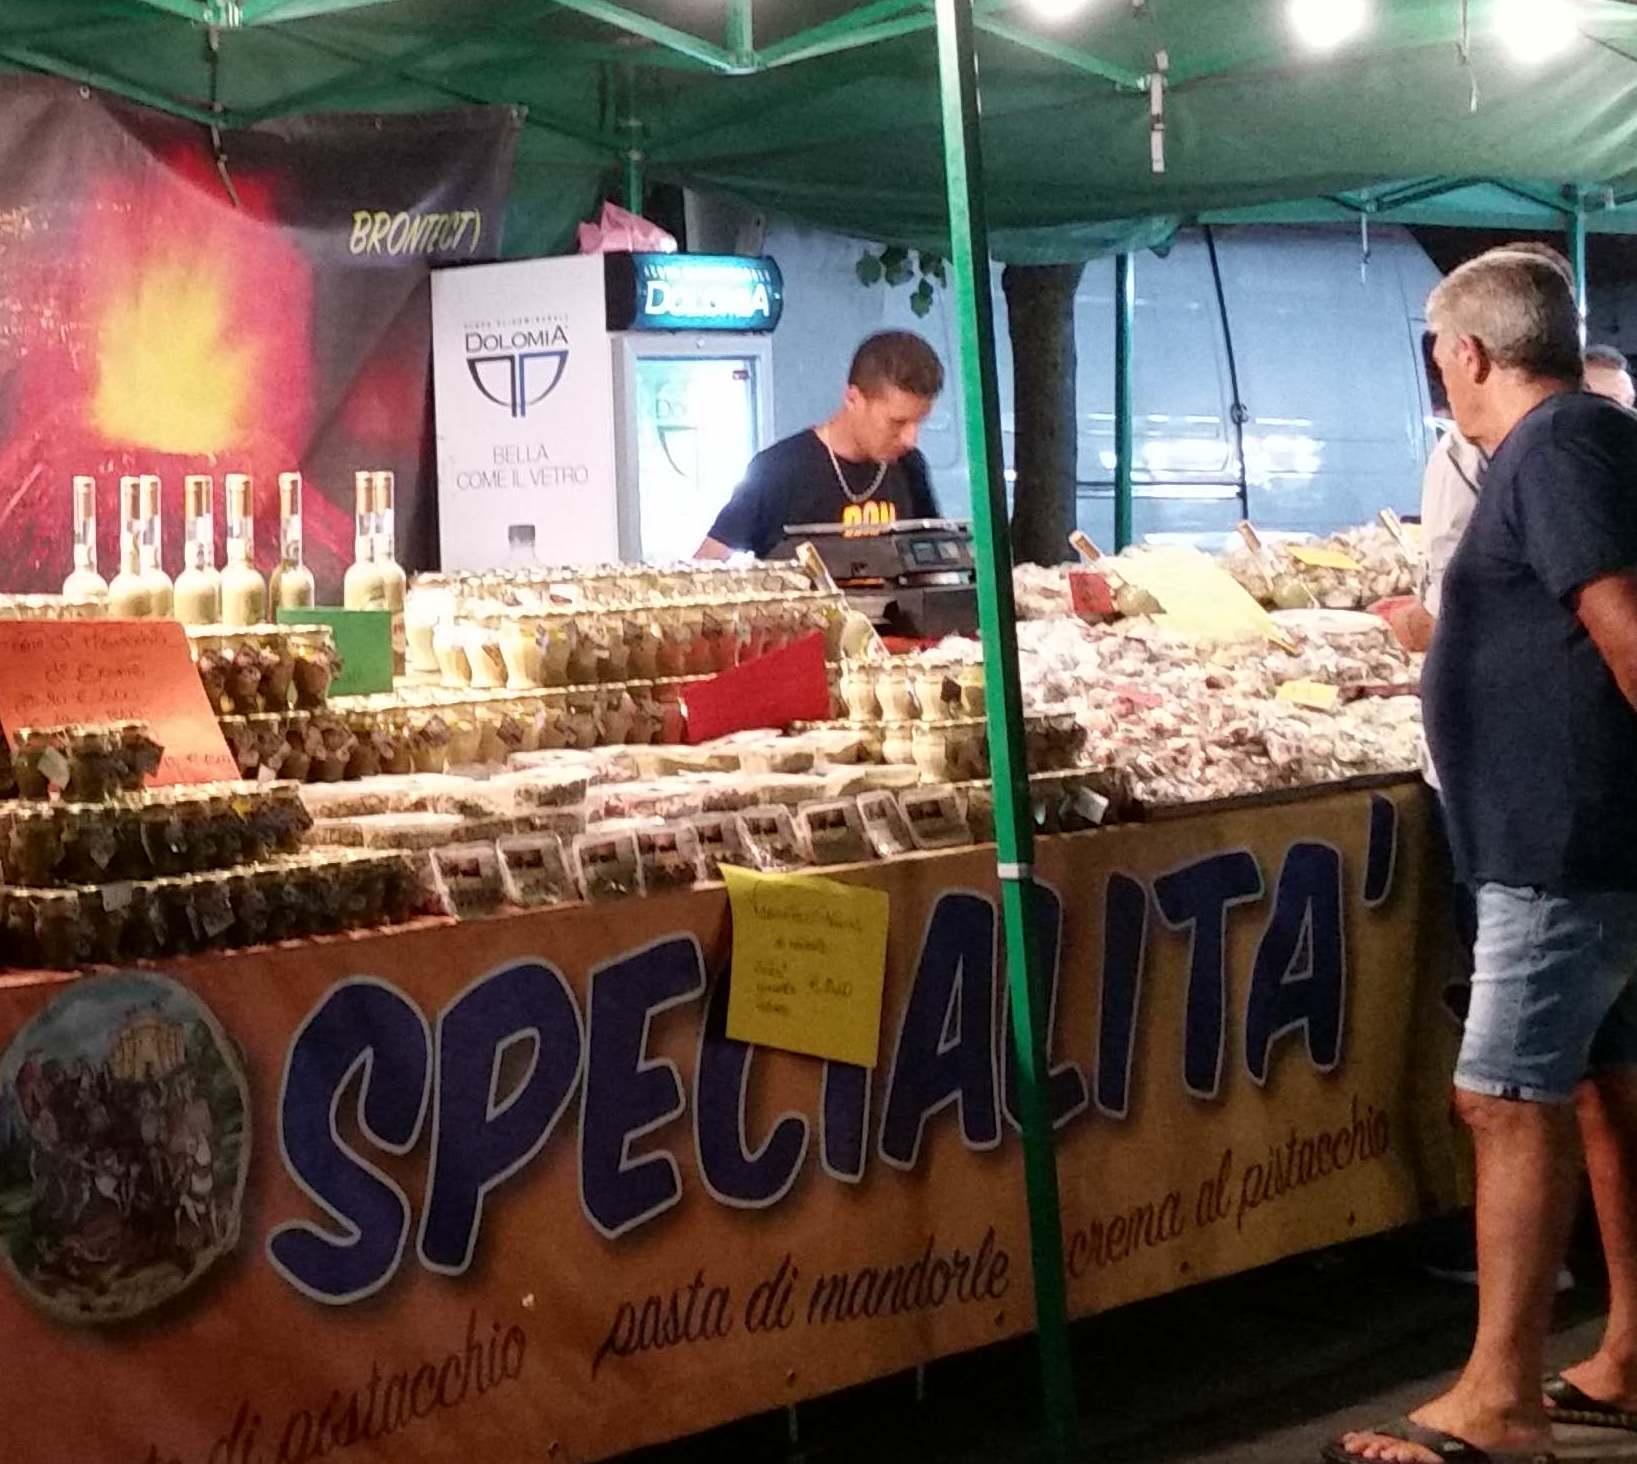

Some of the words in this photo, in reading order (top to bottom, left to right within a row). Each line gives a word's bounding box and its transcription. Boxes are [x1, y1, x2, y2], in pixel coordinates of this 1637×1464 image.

[464, 324, 569, 353] DOLOMIA
[493, 443, 549, 464] BELLA
[456, 470, 505, 490] COME
[529, 464, 589, 486] VETRO
[1067, 1190, 1184, 1279] crema
[1195, 1148, 1232, 1228] al
[1237, 1092, 1390, 1232] pistacchio
[591, 1268, 733, 1382] pasta
[744, 1252, 799, 1333] di
[806, 1225, 1010, 1326] mandorle
